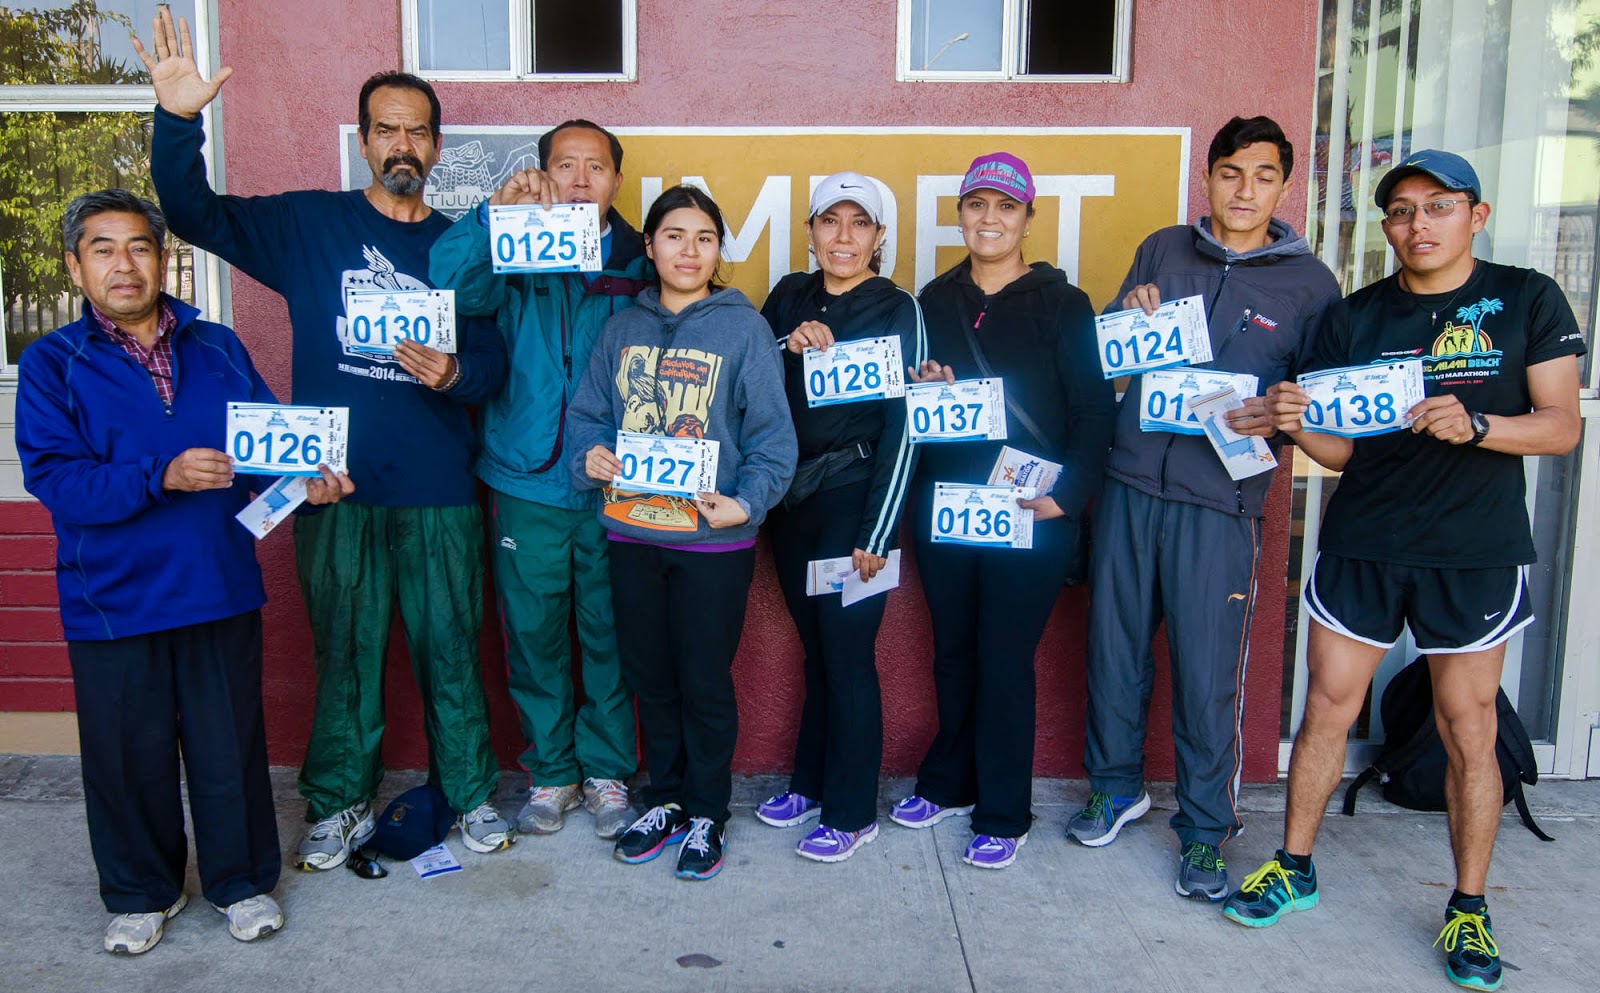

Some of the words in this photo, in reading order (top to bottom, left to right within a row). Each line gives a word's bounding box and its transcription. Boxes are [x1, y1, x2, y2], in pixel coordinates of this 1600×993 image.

[426, 193, 491, 207] TIJUA
[497, 231, 577, 263] 0125
[353, 315, 431, 345] 0130
[1253, 313, 1278, 328] PEAK
[1105, 326, 1183, 368] 0124
[369, 366, 396, 381] 2014
[809, 362, 882, 397] 0128
[1433, 359, 1467, 372] MIAMI
[1468, 358, 1500, 368] BEACH
[1445, 371, 1490, 379] MARATHON
[913, 403, 984, 434] 0137
[1147, 390, 1204, 422] 01
[1304, 392, 1397, 428] 0138
[233, 430, 322, 465] 0126
[620, 453, 695, 487] 0127
[937, 507, 1011, 537] 0136
